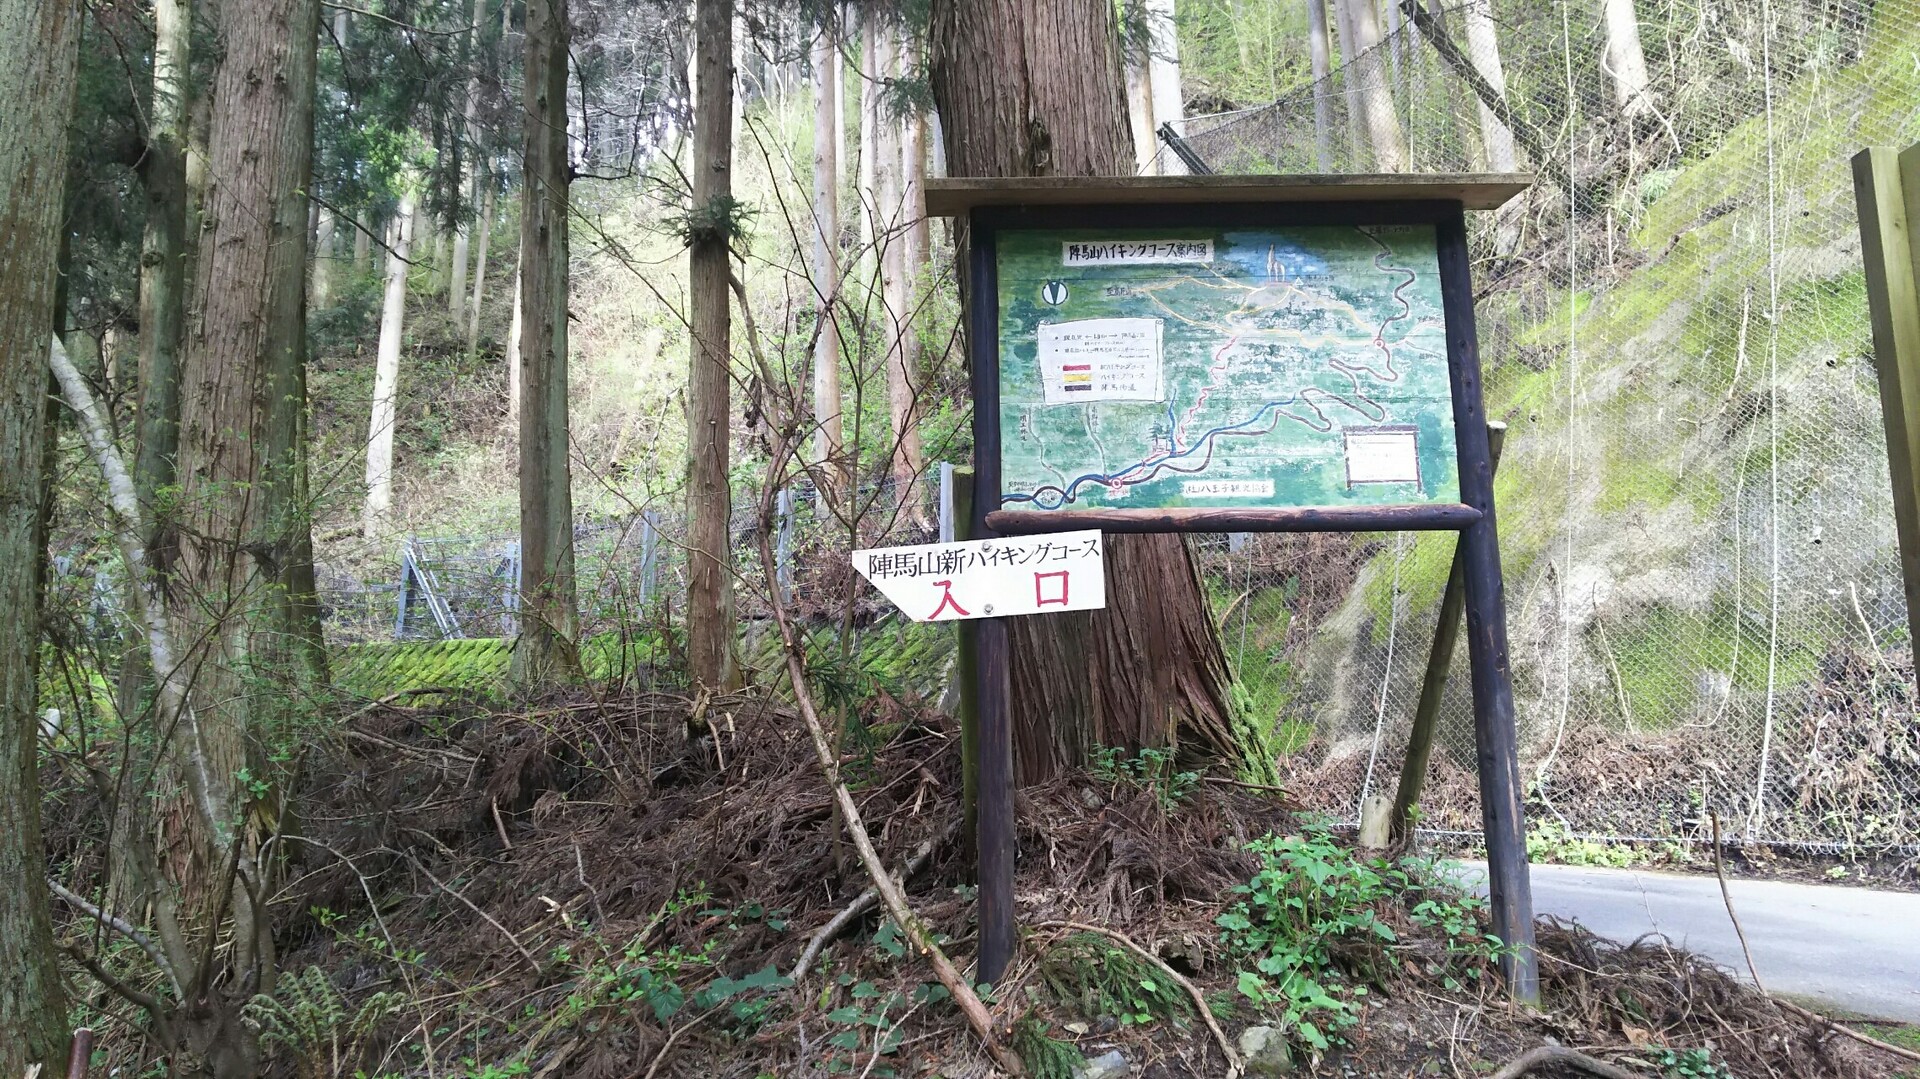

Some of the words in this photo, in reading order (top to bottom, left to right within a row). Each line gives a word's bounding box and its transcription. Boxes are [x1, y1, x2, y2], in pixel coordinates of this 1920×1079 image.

[1069, 242, 1207, 261] 陣馬山ハイキングコース案内図
[869, 538, 1101, 579] 陣馬山新ハイキングコース
